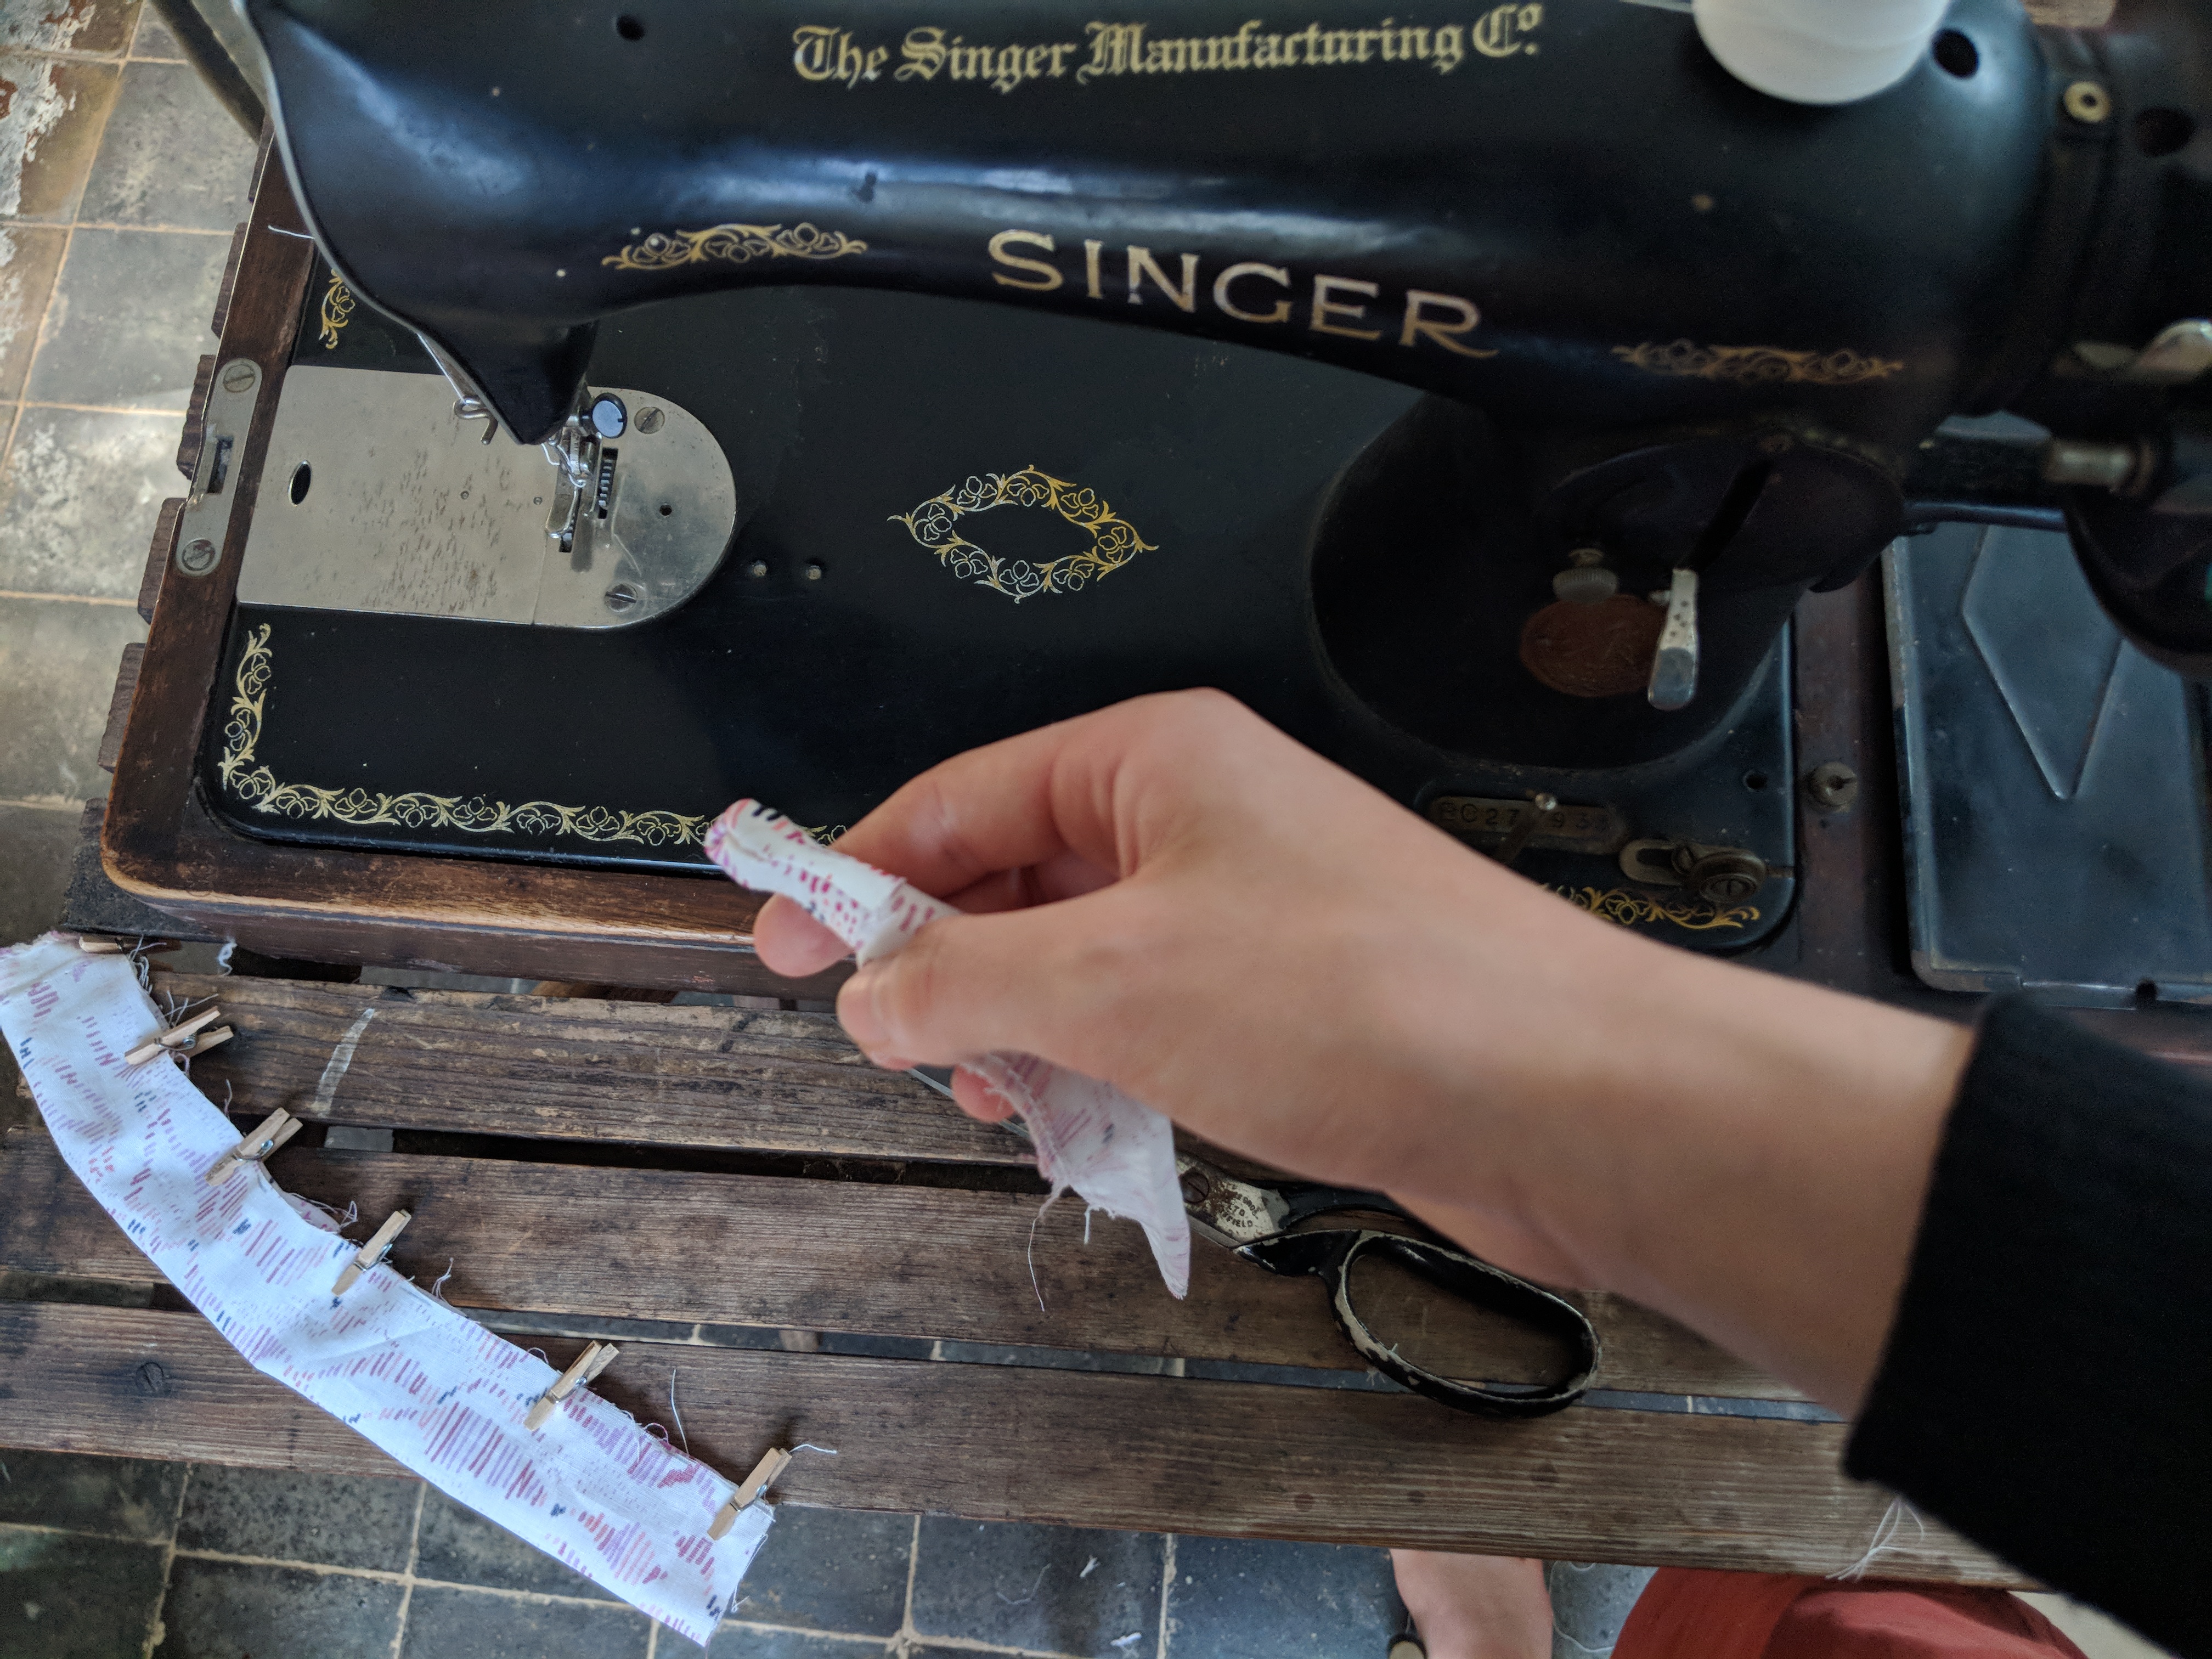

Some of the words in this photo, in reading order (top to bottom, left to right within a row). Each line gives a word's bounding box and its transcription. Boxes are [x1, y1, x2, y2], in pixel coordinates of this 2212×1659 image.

[792, 25, 889, 89] The
[894, 26, 1077, 95] Singer
[1076, 17, 1464, 86] Manufacturing
[988, 229, 1499, 359] SINGER
